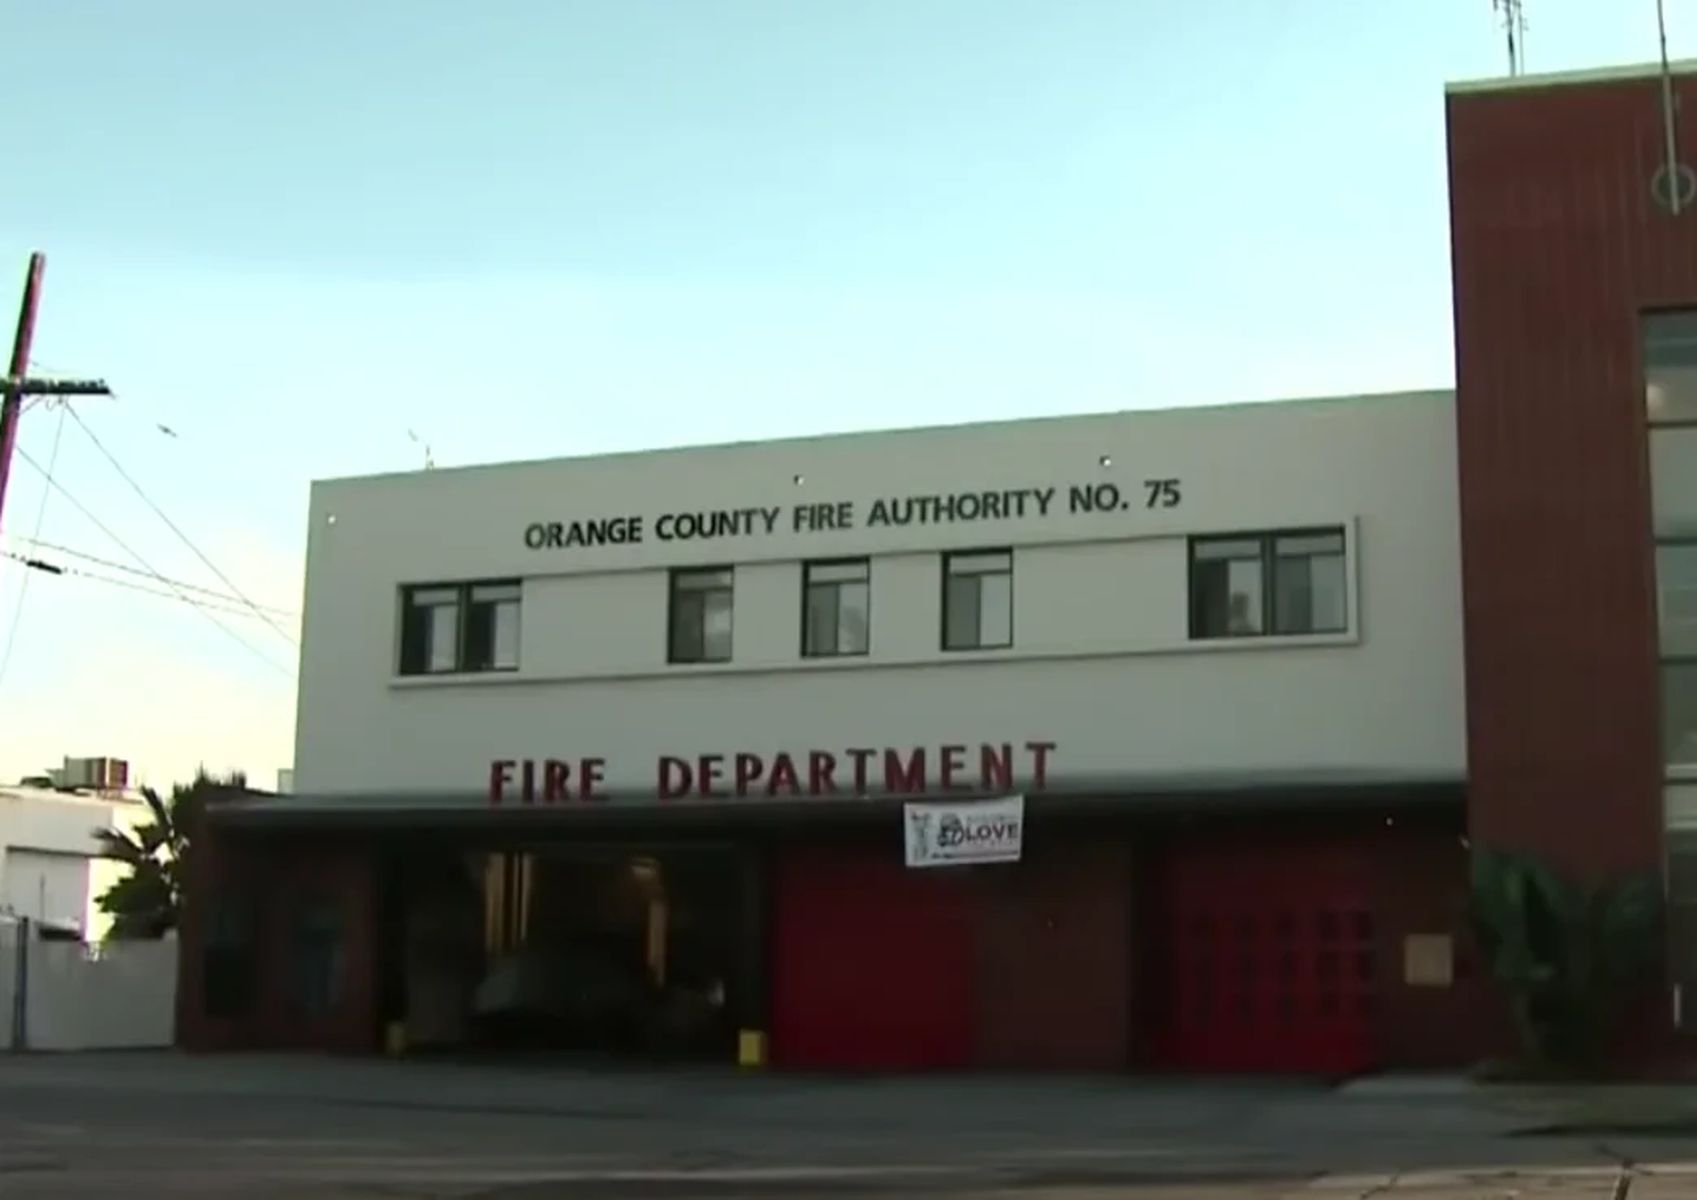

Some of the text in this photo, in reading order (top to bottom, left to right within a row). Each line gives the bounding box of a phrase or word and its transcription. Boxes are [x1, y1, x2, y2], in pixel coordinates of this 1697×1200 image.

[524, 478, 1182, 549] ORANGE COUNTY FIRE AUTHORITY NO. 75
[490, 741, 1056, 804] FIRE DEPARTMENT
[965, 822, 1018, 842] LOVE
